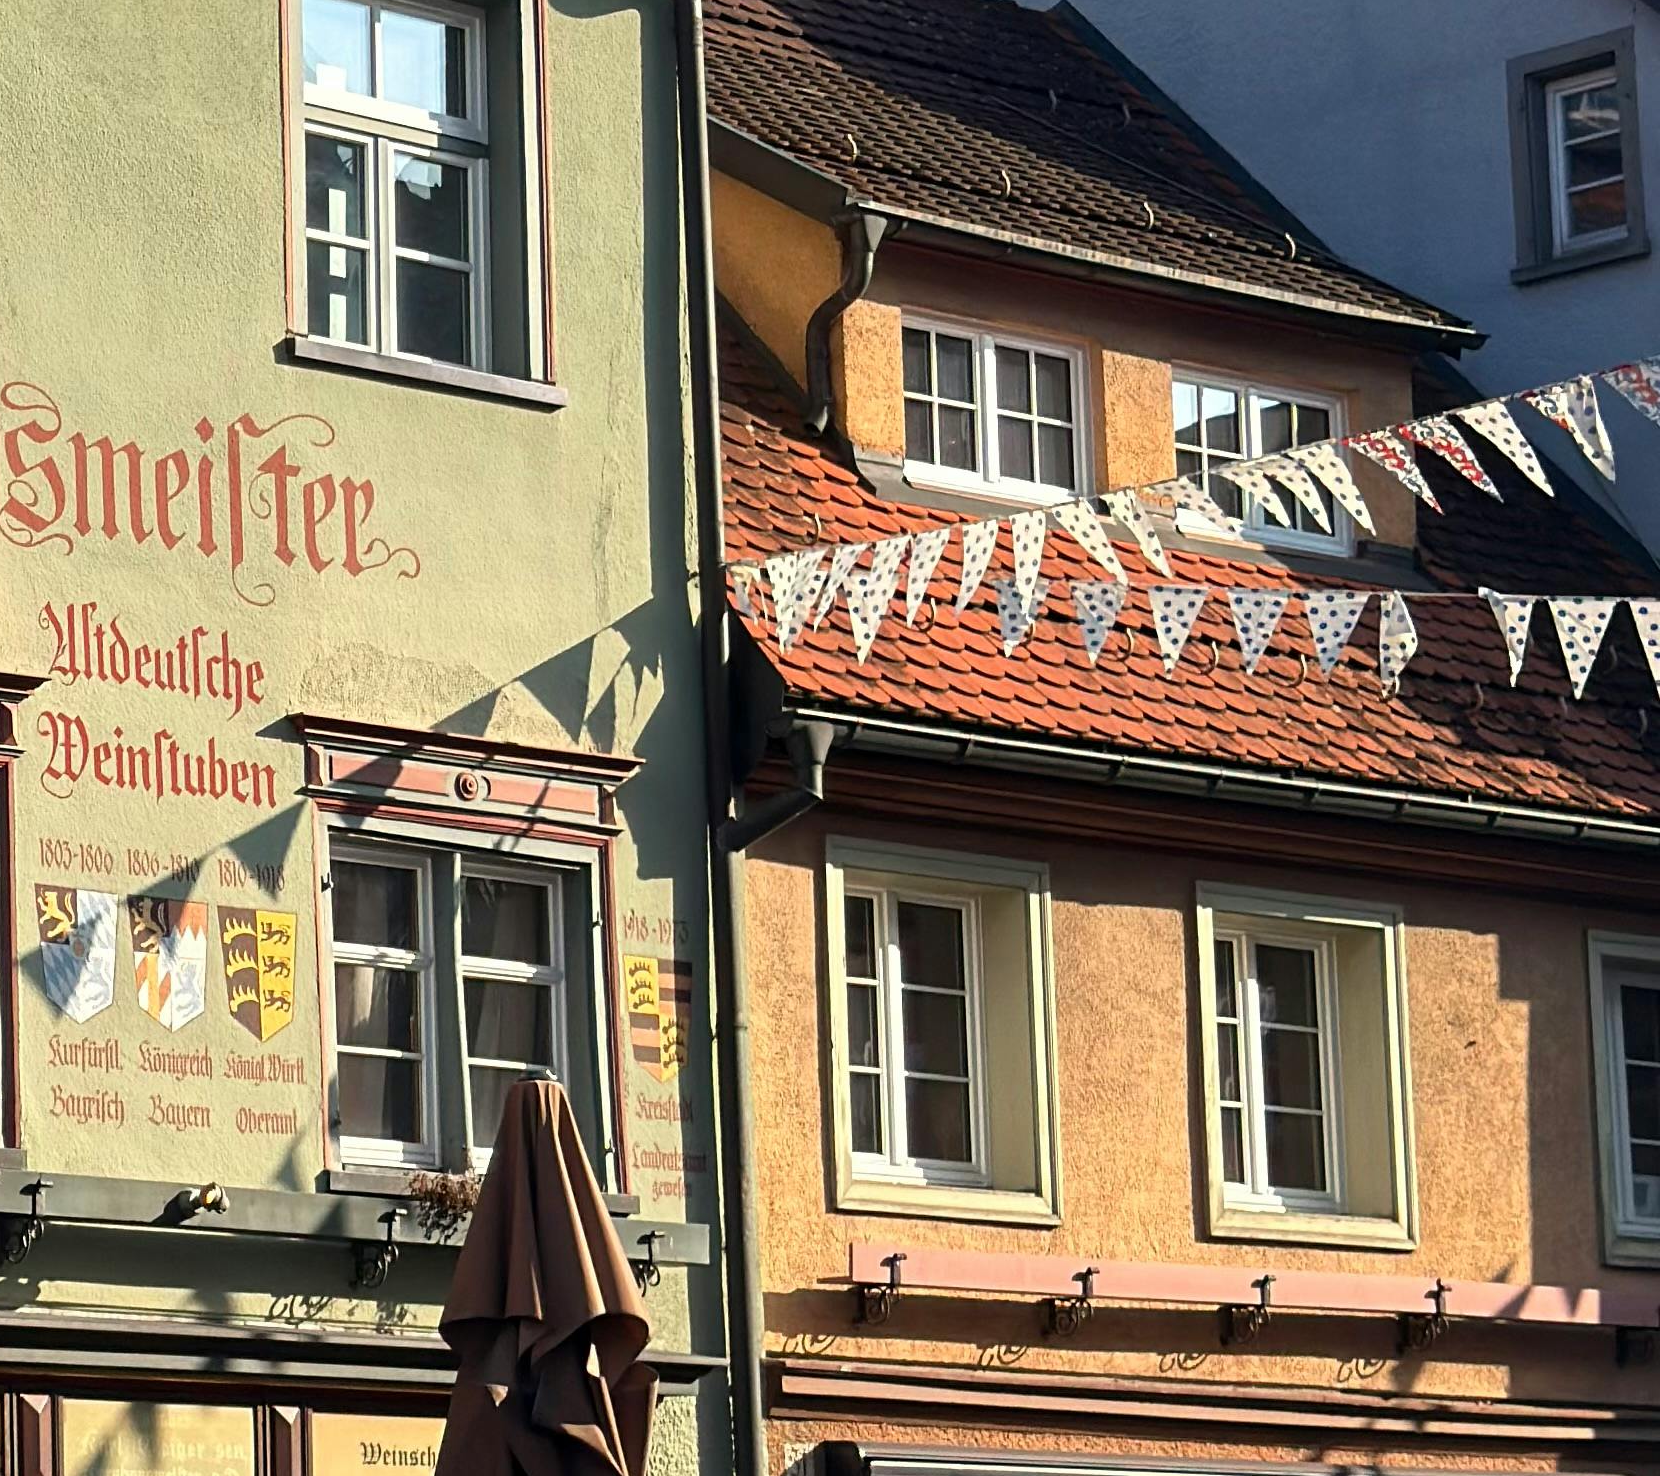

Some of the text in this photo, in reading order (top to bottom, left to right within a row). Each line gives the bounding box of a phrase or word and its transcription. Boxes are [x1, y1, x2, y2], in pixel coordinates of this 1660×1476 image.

[139, 1040, 213, 1081] Königreich
[148, 1094, 211, 1131] Bayern
[360, 1442, 437, 1469] Weinsch
